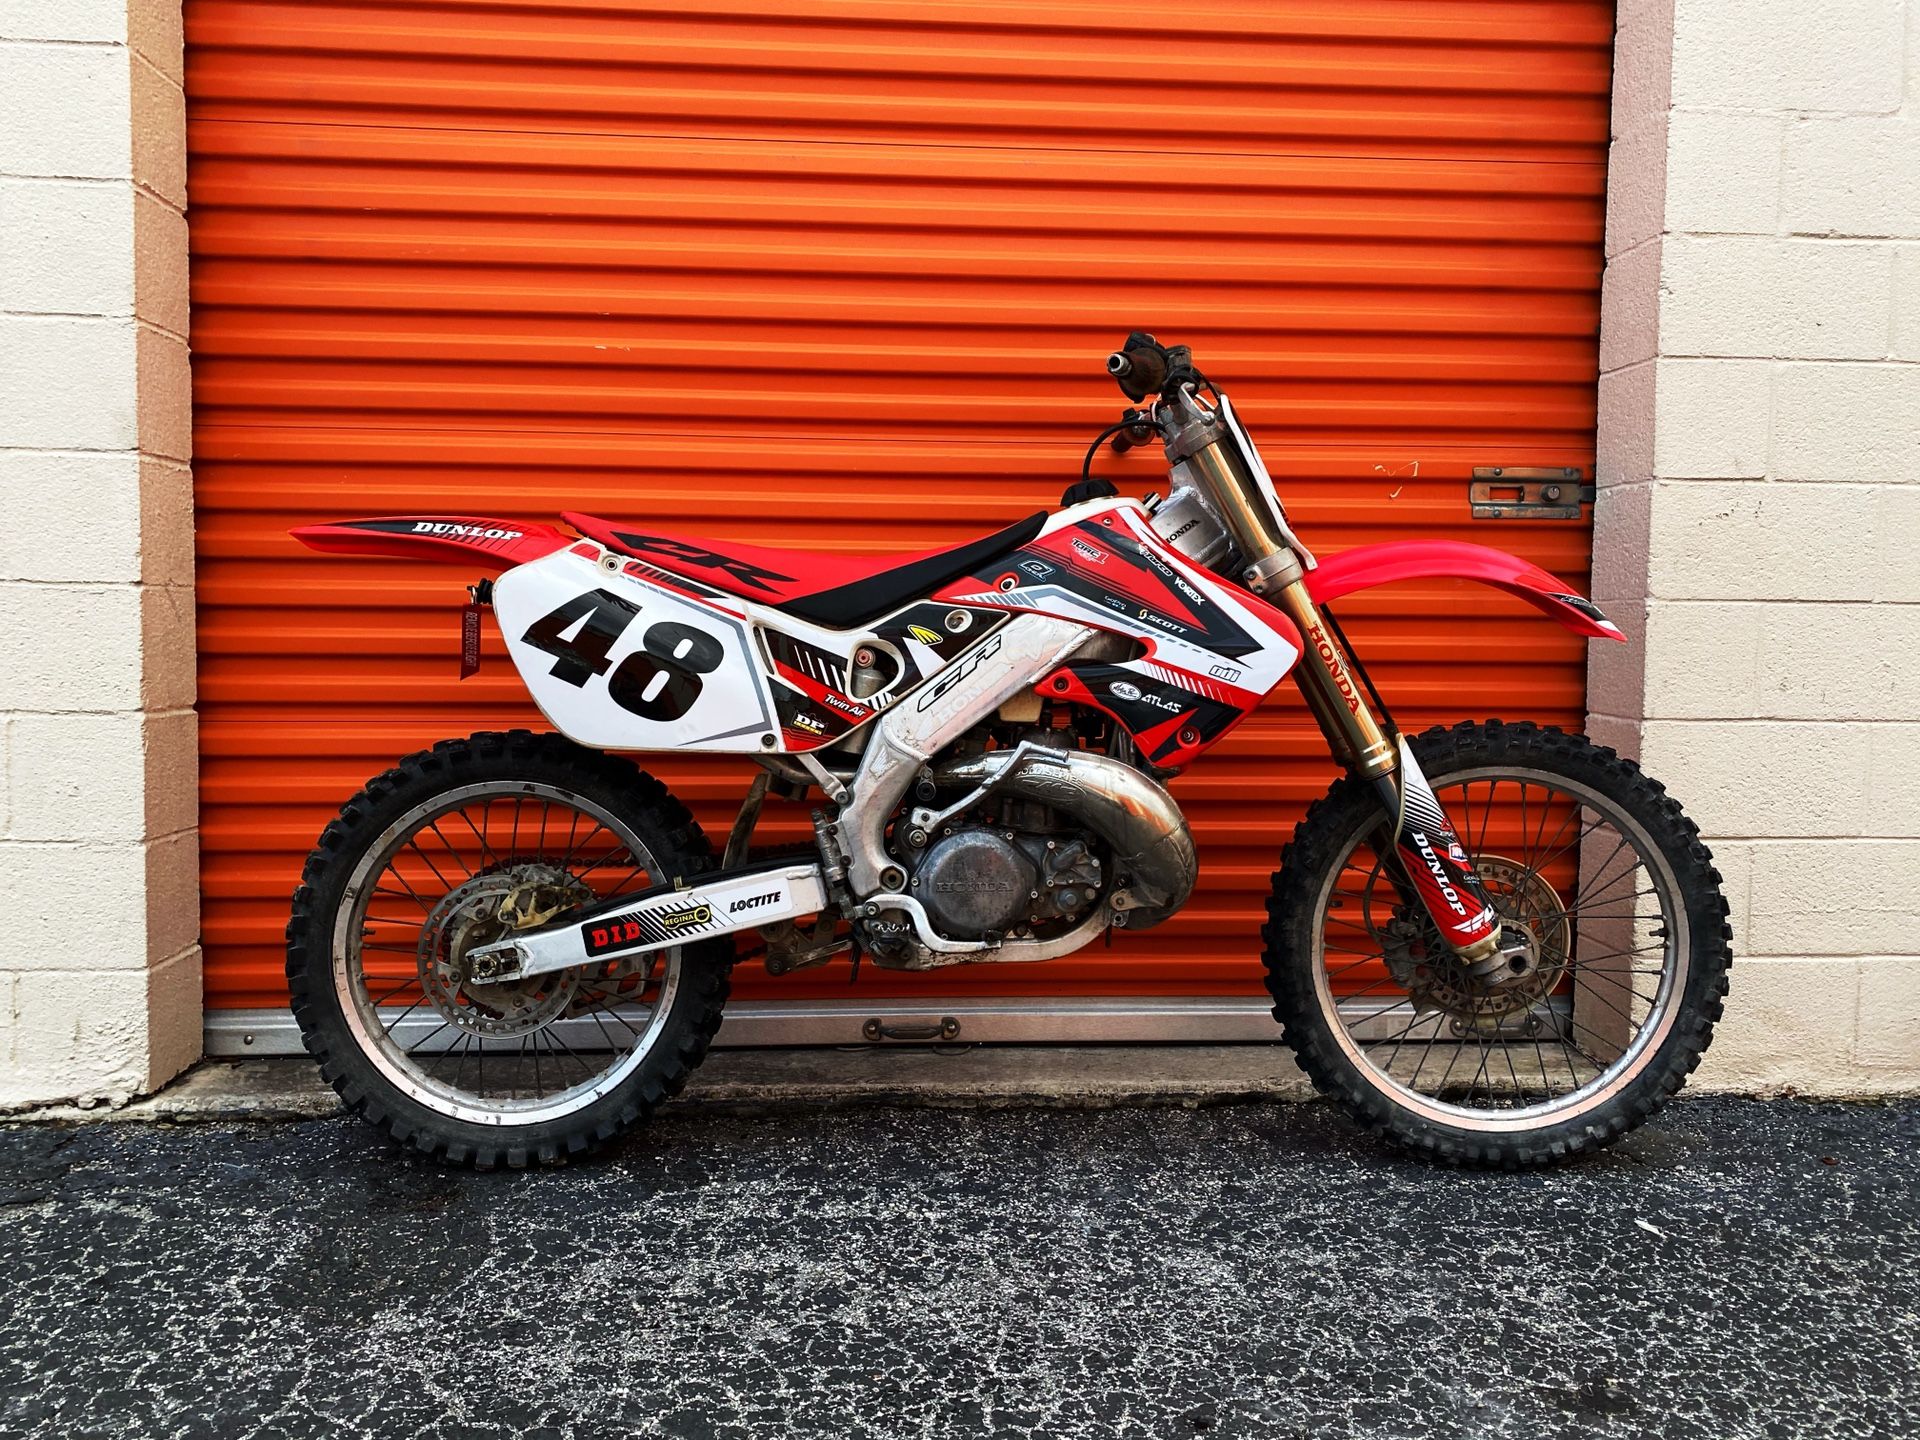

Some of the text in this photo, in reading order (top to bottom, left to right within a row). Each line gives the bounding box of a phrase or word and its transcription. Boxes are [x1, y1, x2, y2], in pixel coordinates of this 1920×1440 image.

[412, 522, 523, 541] DUNLOP
[610, 530, 801, 596] CR
[1174, 576, 1206, 606] VORTEX
[1147, 613, 1188, 633] SCOTT
[520, 587, 724, 722] 48
[917, 634, 1002, 713] CR
[1307, 623, 1360, 716] HONDA
[824, 693, 867, 718] Twin Air
[1141, 693, 1182, 713] ATLAS
[795, 713, 825, 729] DP
[1412, 831, 1467, 916] DUNLOP
[936, 882, 1014, 893] HONDA
[729, 891, 782, 914] LOCTITE
[664, 914, 694, 926] REGINA
